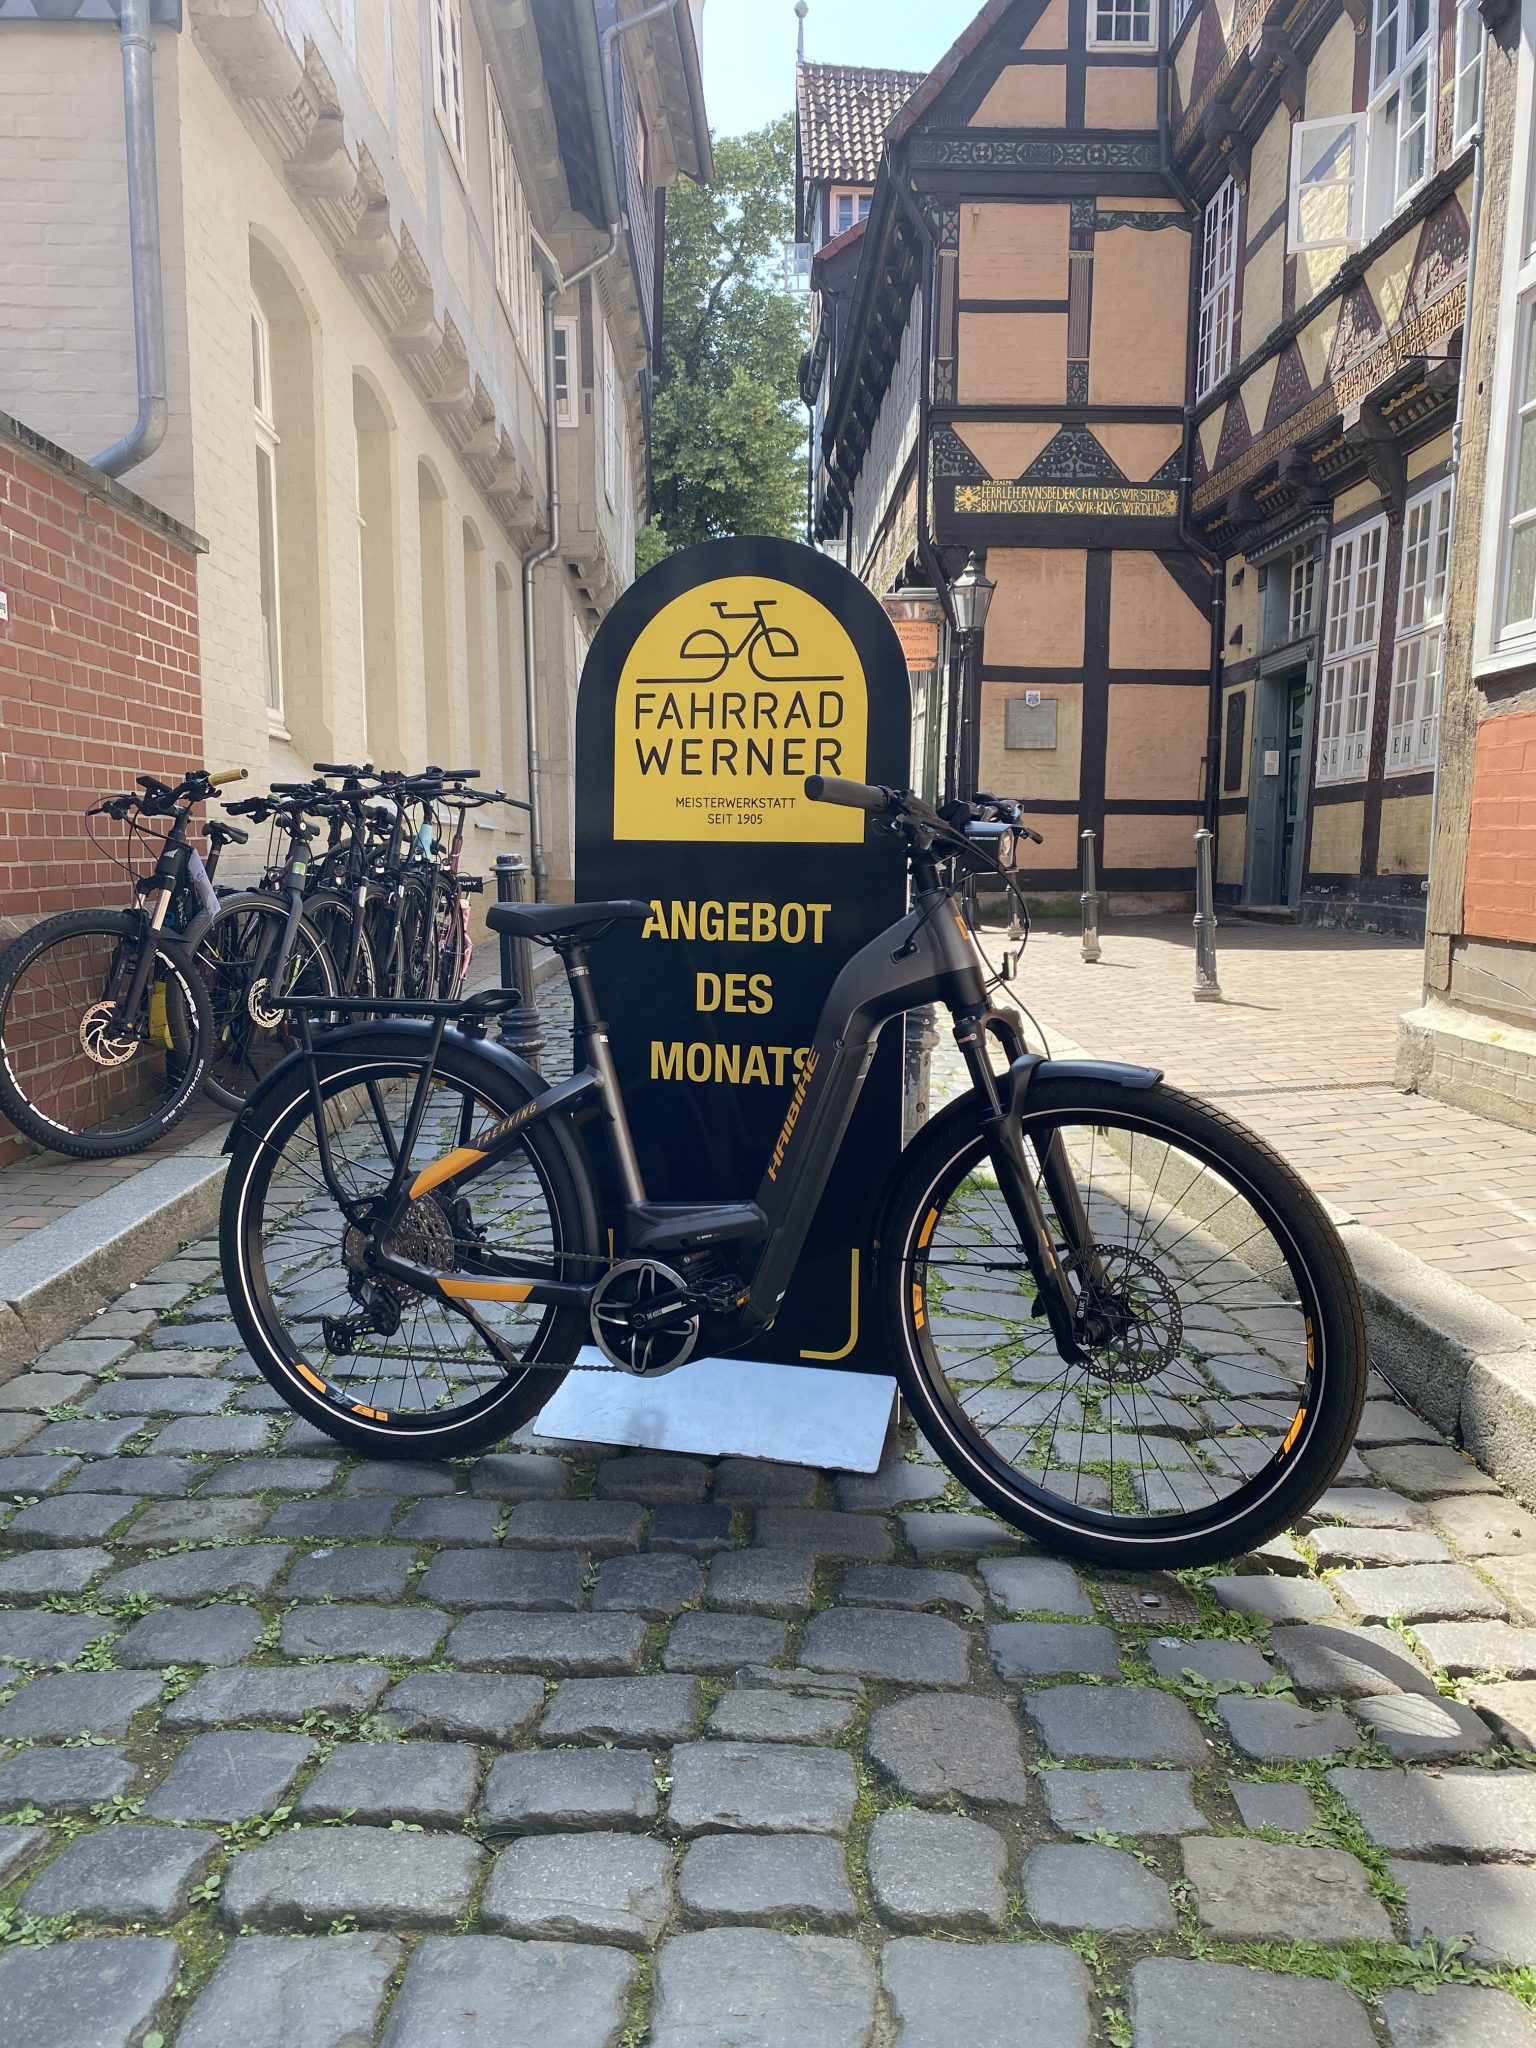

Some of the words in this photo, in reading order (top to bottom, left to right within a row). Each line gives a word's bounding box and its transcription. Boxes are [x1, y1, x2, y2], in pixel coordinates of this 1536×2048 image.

[635, 691, 844, 729] FAHRRAD
[635, 738, 842, 776] WERNER
[675, 797, 796, 809] MEISTERWERKSTATT
[707, 813, 733, 825] SEIT
[737, 813, 763, 825] 1905
[641, 900, 832, 944] ANGEBOT
[696, 972, 774, 1015] DES
[650, 1040, 811, 1086] MONATS
[476, 1102, 537, 1148] TREKKING
[767, 1044, 820, 1181] HAIBIKE
